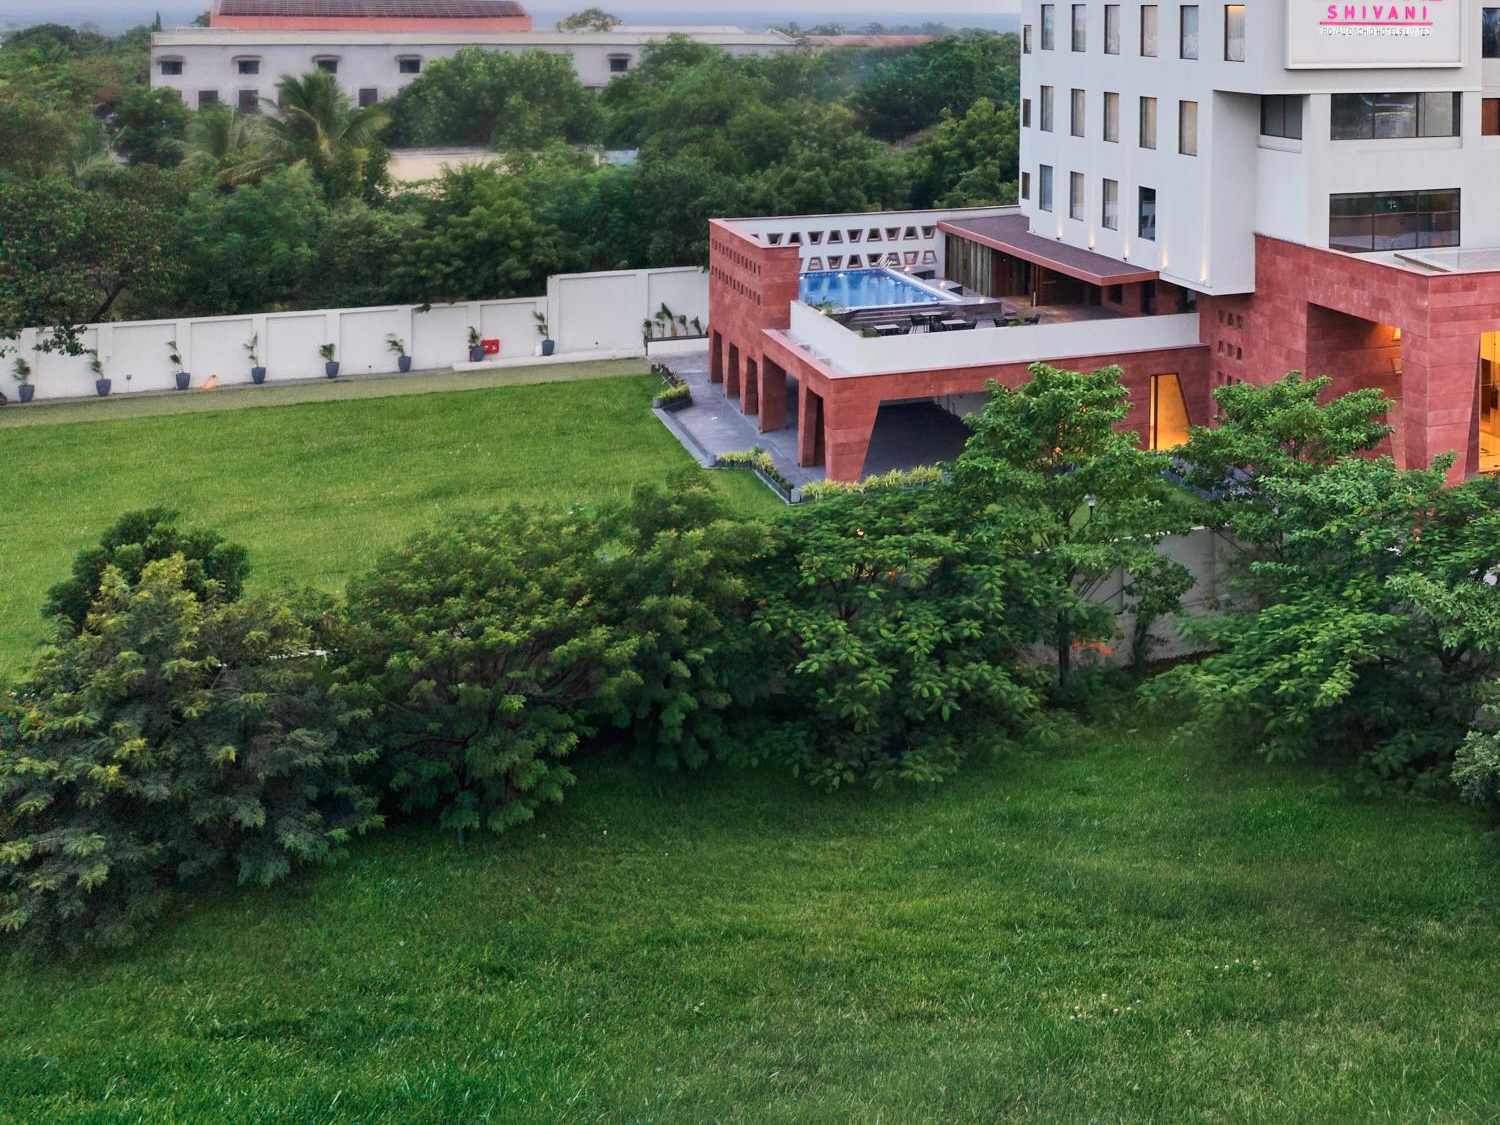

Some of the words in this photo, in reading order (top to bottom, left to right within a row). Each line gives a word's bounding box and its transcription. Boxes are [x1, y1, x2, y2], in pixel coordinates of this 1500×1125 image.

[1327, 4, 1428, 20] SHIVANI
[1322, 27, 1346, 36] ROYAL
[1348, 27, 1374, 36] ORCHID
[1376, 27, 1402, 36] HOTELS
